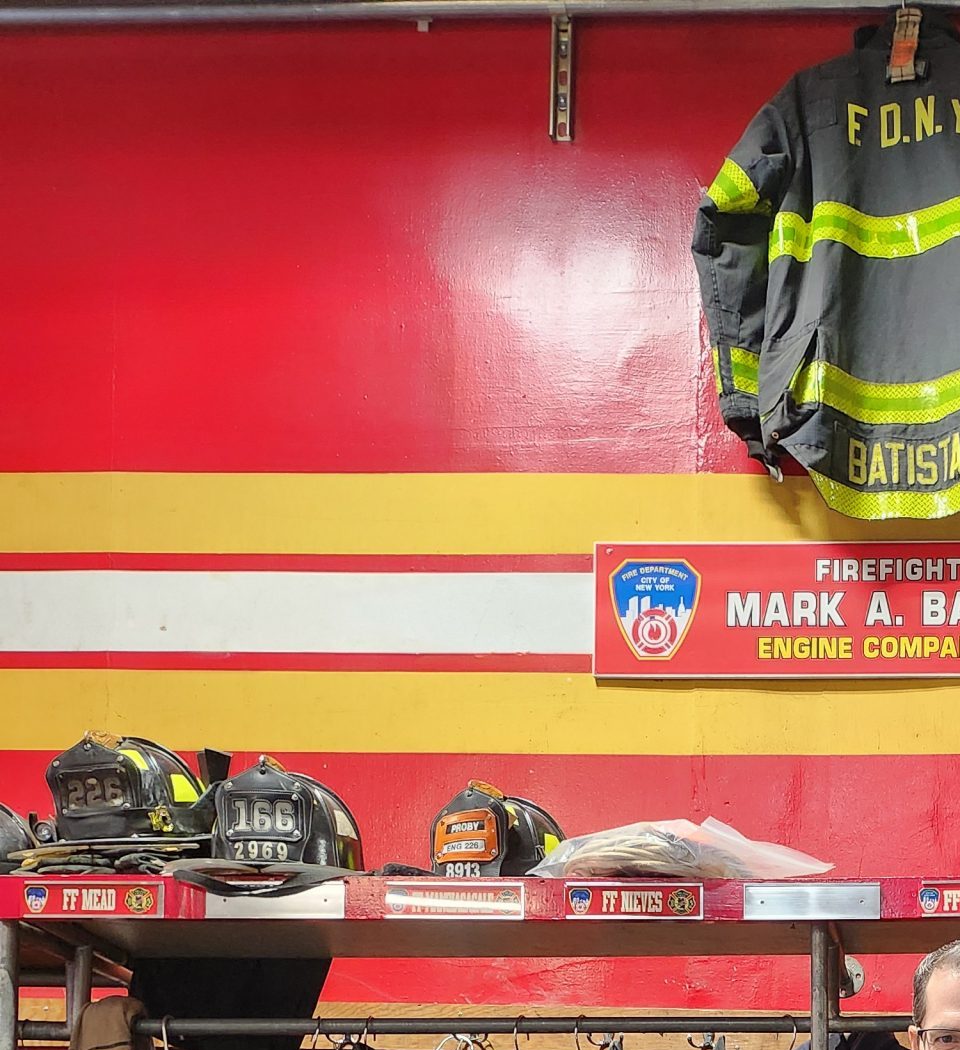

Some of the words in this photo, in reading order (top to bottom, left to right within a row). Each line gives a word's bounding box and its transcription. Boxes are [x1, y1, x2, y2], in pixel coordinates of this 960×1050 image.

[621, 568, 638, 581] FIRE
[639, 566, 688, 581] DEPARTMENT
[640, 576, 657, 584] CITY
[659, 576, 670, 584] OF
[635, 584, 653, 592] NEW
[654, 584, 675, 592] YORK
[726, 591, 847, 627] MARK
[864, 591, 904, 627] A.
[757, 635, 853, 660] ENGINE
[67, 777, 124, 811] 226
[231, 799, 297, 832] 166
[450, 820, 480, 834] PROBY
[234, 840, 288, 861] 2969
[446, 842, 463, 852] ENG
[464, 841, 480, 850] 226
[445, 861, 480, 878] 8913
[62, 888, 79, 911] FF
[81, 888, 117, 911] MEAD
[601, 890, 618, 913] FF
[620, 890, 663, 913] NIEVES
[943, 889, 960, 911] FF
